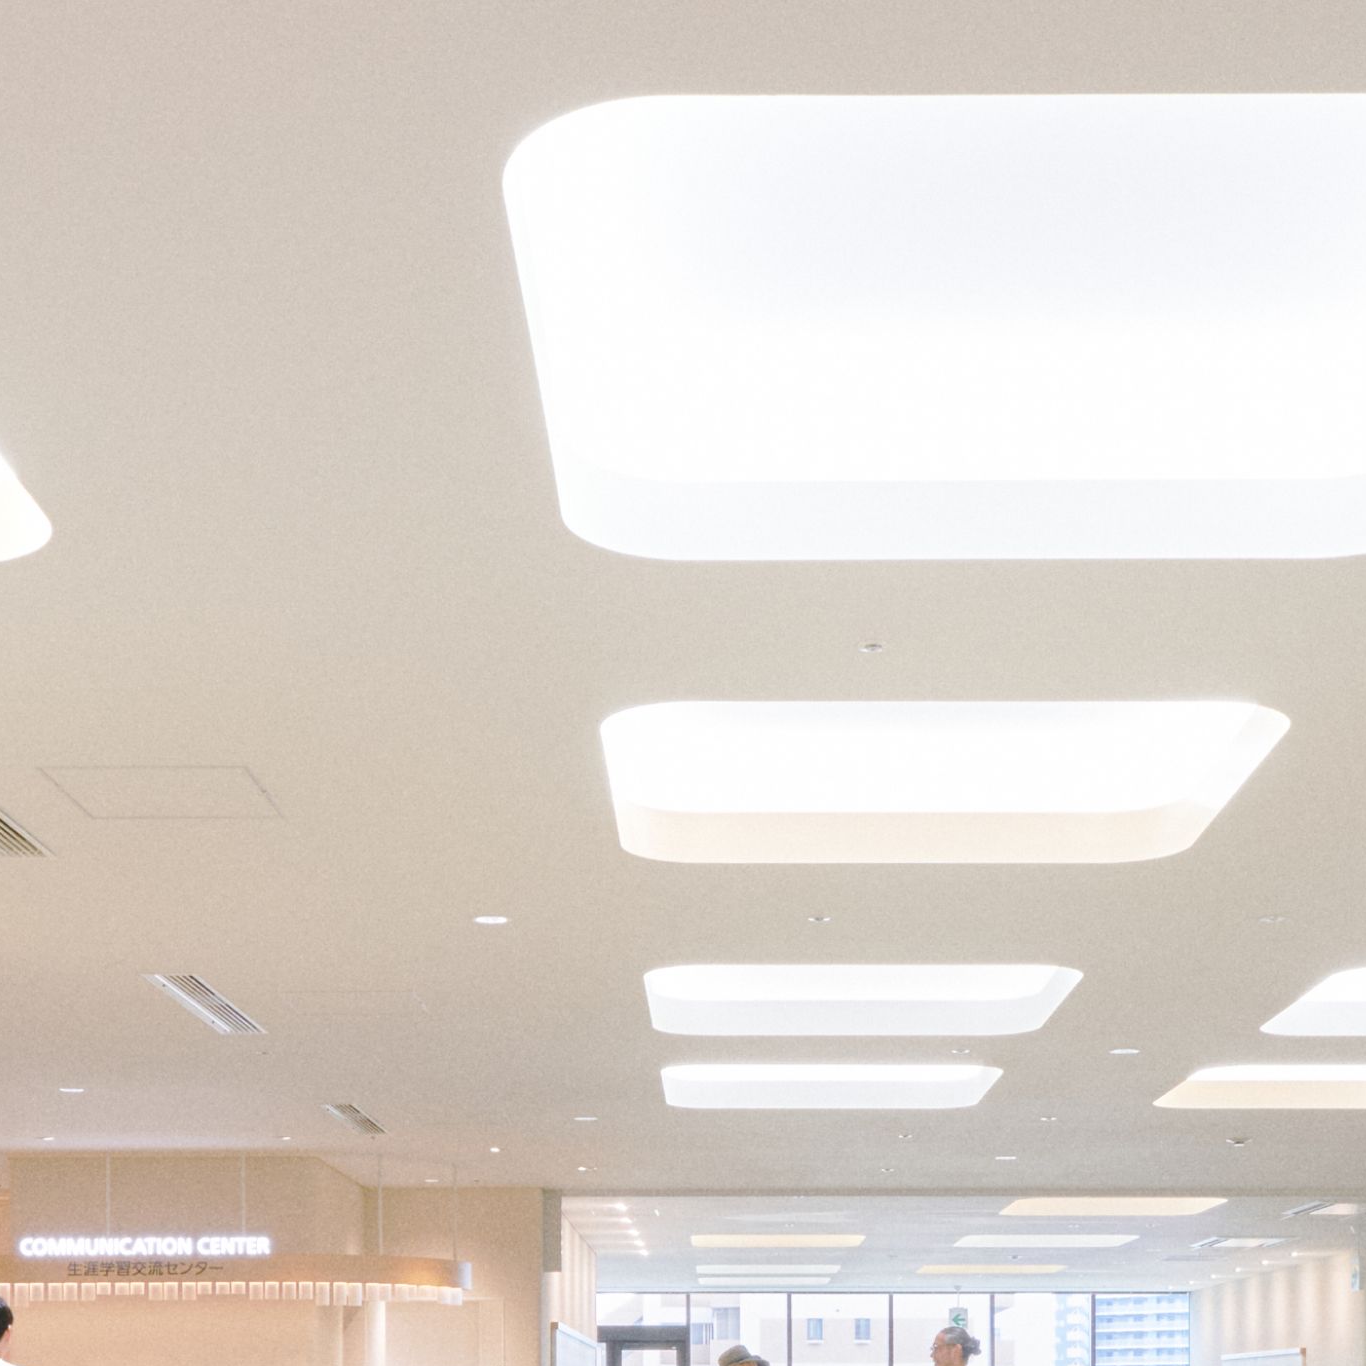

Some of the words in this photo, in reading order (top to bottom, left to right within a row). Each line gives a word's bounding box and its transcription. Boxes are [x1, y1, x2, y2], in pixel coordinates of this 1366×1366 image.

[19, 1236, 193, 1257] COMMUNICATION
[196, 1236, 271, 1256] CENTER
[67, 1260, 224, 1277] 生涯学習交流センター
